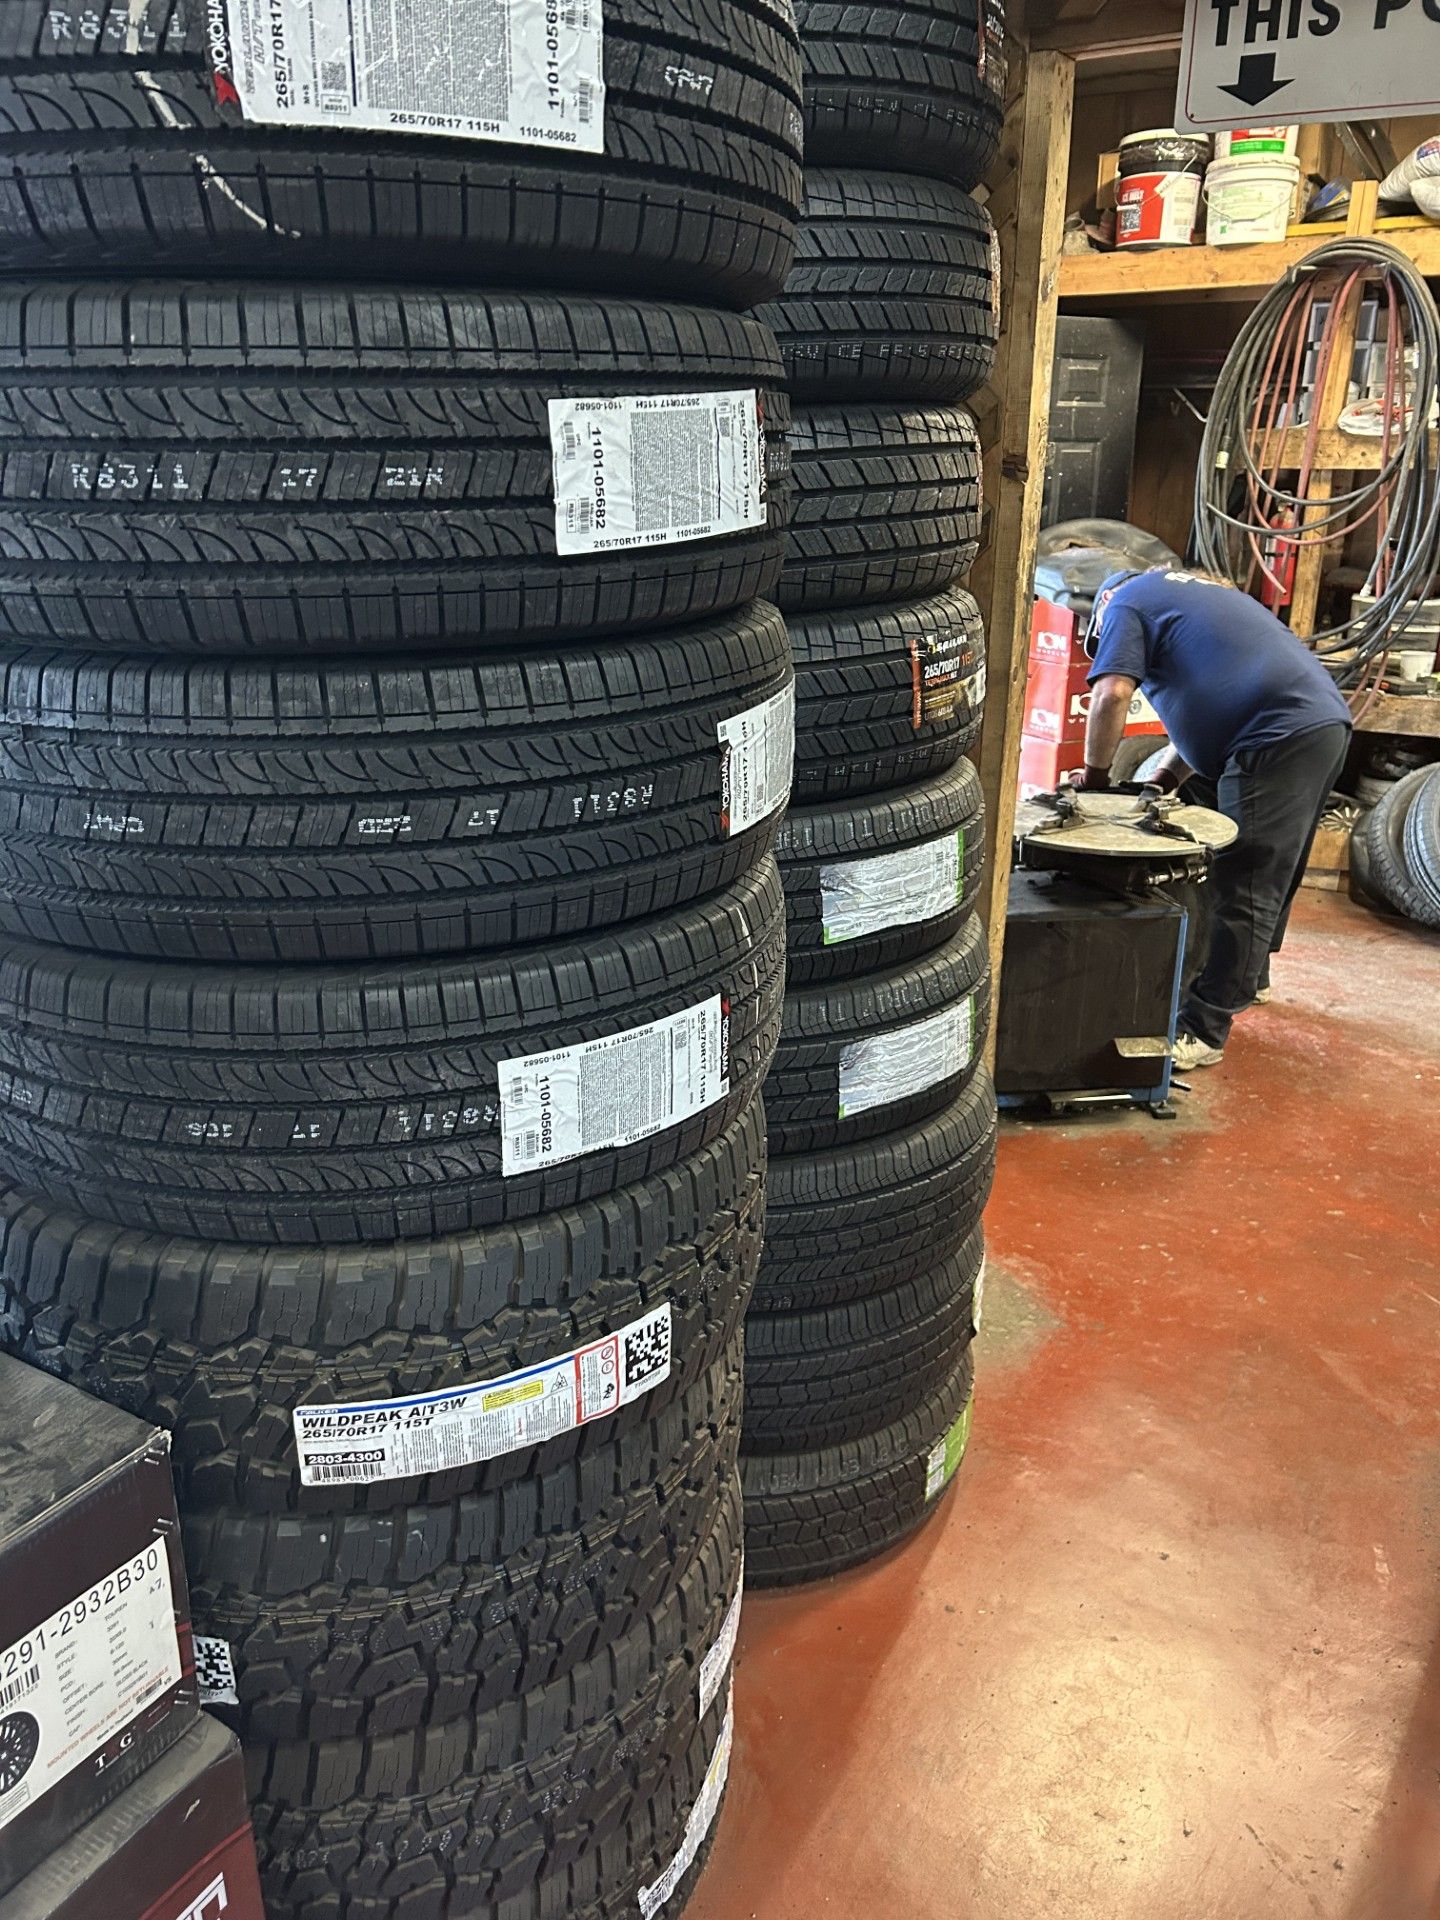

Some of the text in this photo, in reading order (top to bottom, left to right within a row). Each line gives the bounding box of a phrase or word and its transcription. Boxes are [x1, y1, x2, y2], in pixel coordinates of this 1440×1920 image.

[1211, 0, 1340, 46] THIS
[270, 0, 289, 109] 265/70R17
[389, 112, 500, 133] 265/70R17 115H
[520, 126, 577, 142] 1101-05682
[575, 402, 623, 411] 1101-05682
[71, 464, 189, 490] R8311
[281, 467, 318, 488] 17
[591, 427, 606, 530] 1101-05682
[593, 532, 667, 548] 265/70R17 115H
[676, 525, 711, 538] 1101-05682
[1037, 632, 1067, 650] ION
[924, 656, 960, 679] 265/70R17
[1030, 708, 1060, 729] ION
[573, 783, 653, 819] R8311
[586, 1026, 654, 1053] 265/70R17 115H
[699, 1010, 707, 1070] 265/70R17
[721, 1016, 729, 1074] YOKOHAMA
[524, 1051, 570, 1068] 1101-05682
[540, 1076, 552, 1153] 1101-05682
[302, 1397, 468, 1428] WILDPEAK A/T3W
[302, 1416, 434, 1439] 265/70R17 115T
[308, 1450, 383, 1465] 2803-4300
[0, 1549, 158, 1676] 291-2932B30
[118, 1695, 131, 1711] NOT
